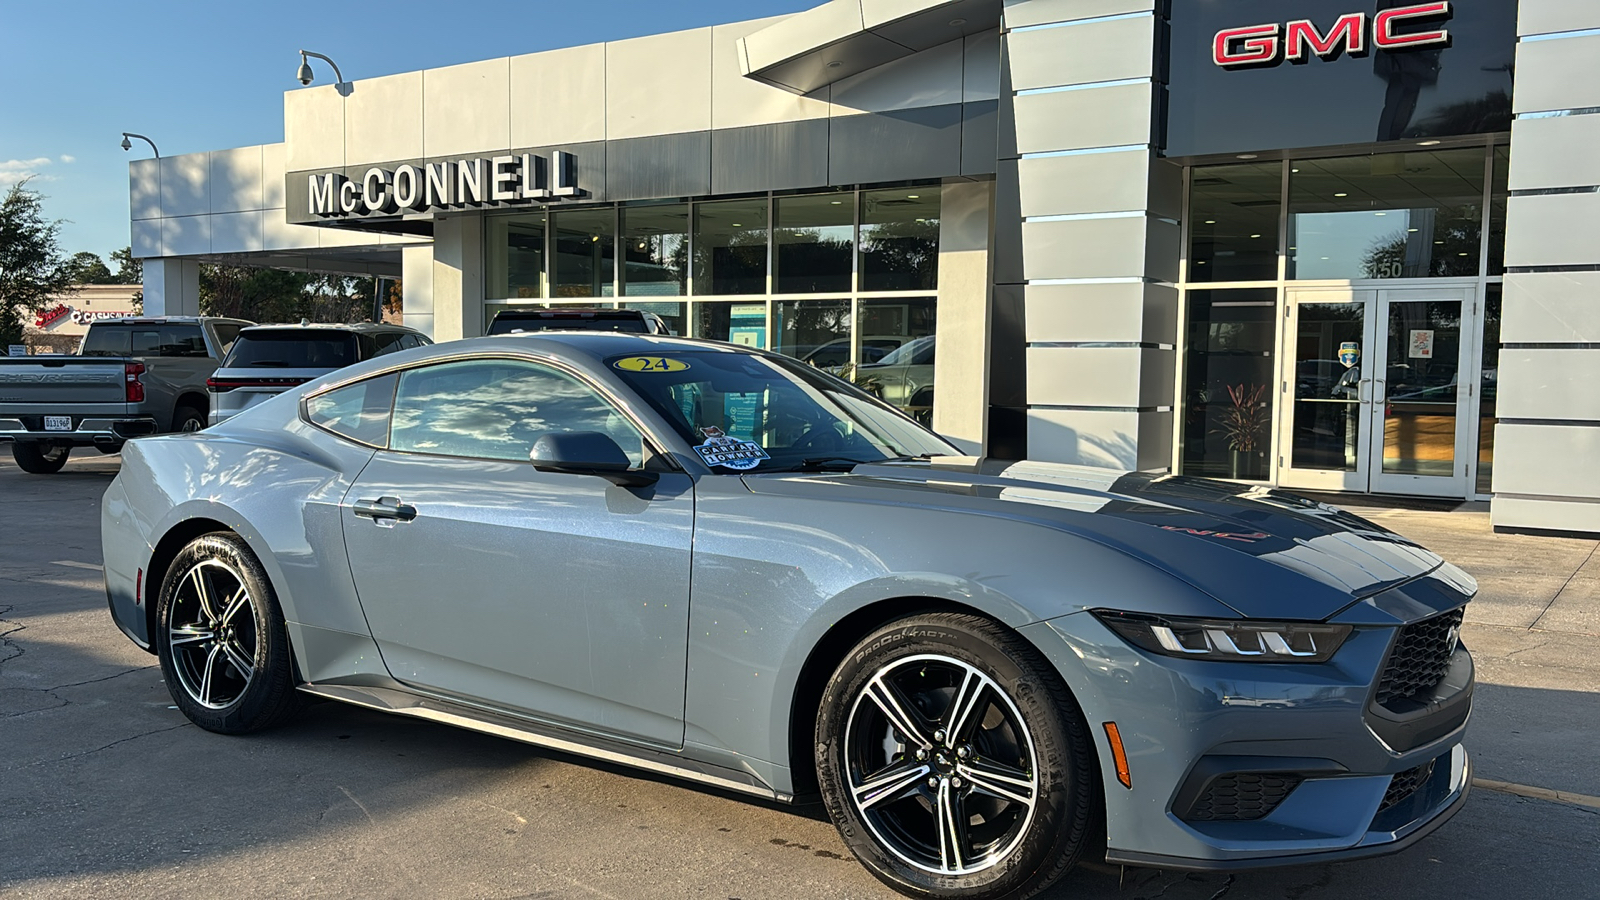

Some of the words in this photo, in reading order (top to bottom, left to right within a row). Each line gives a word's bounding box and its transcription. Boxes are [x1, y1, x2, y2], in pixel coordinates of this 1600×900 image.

[1212, 1, 1449, 67] GMC
[308, 149, 576, 215] McCONNELL
[1371, 262, 1403, 279] 150
[638, 357, 671, 372] 24
[701, 442, 759, 455] CARFAX
